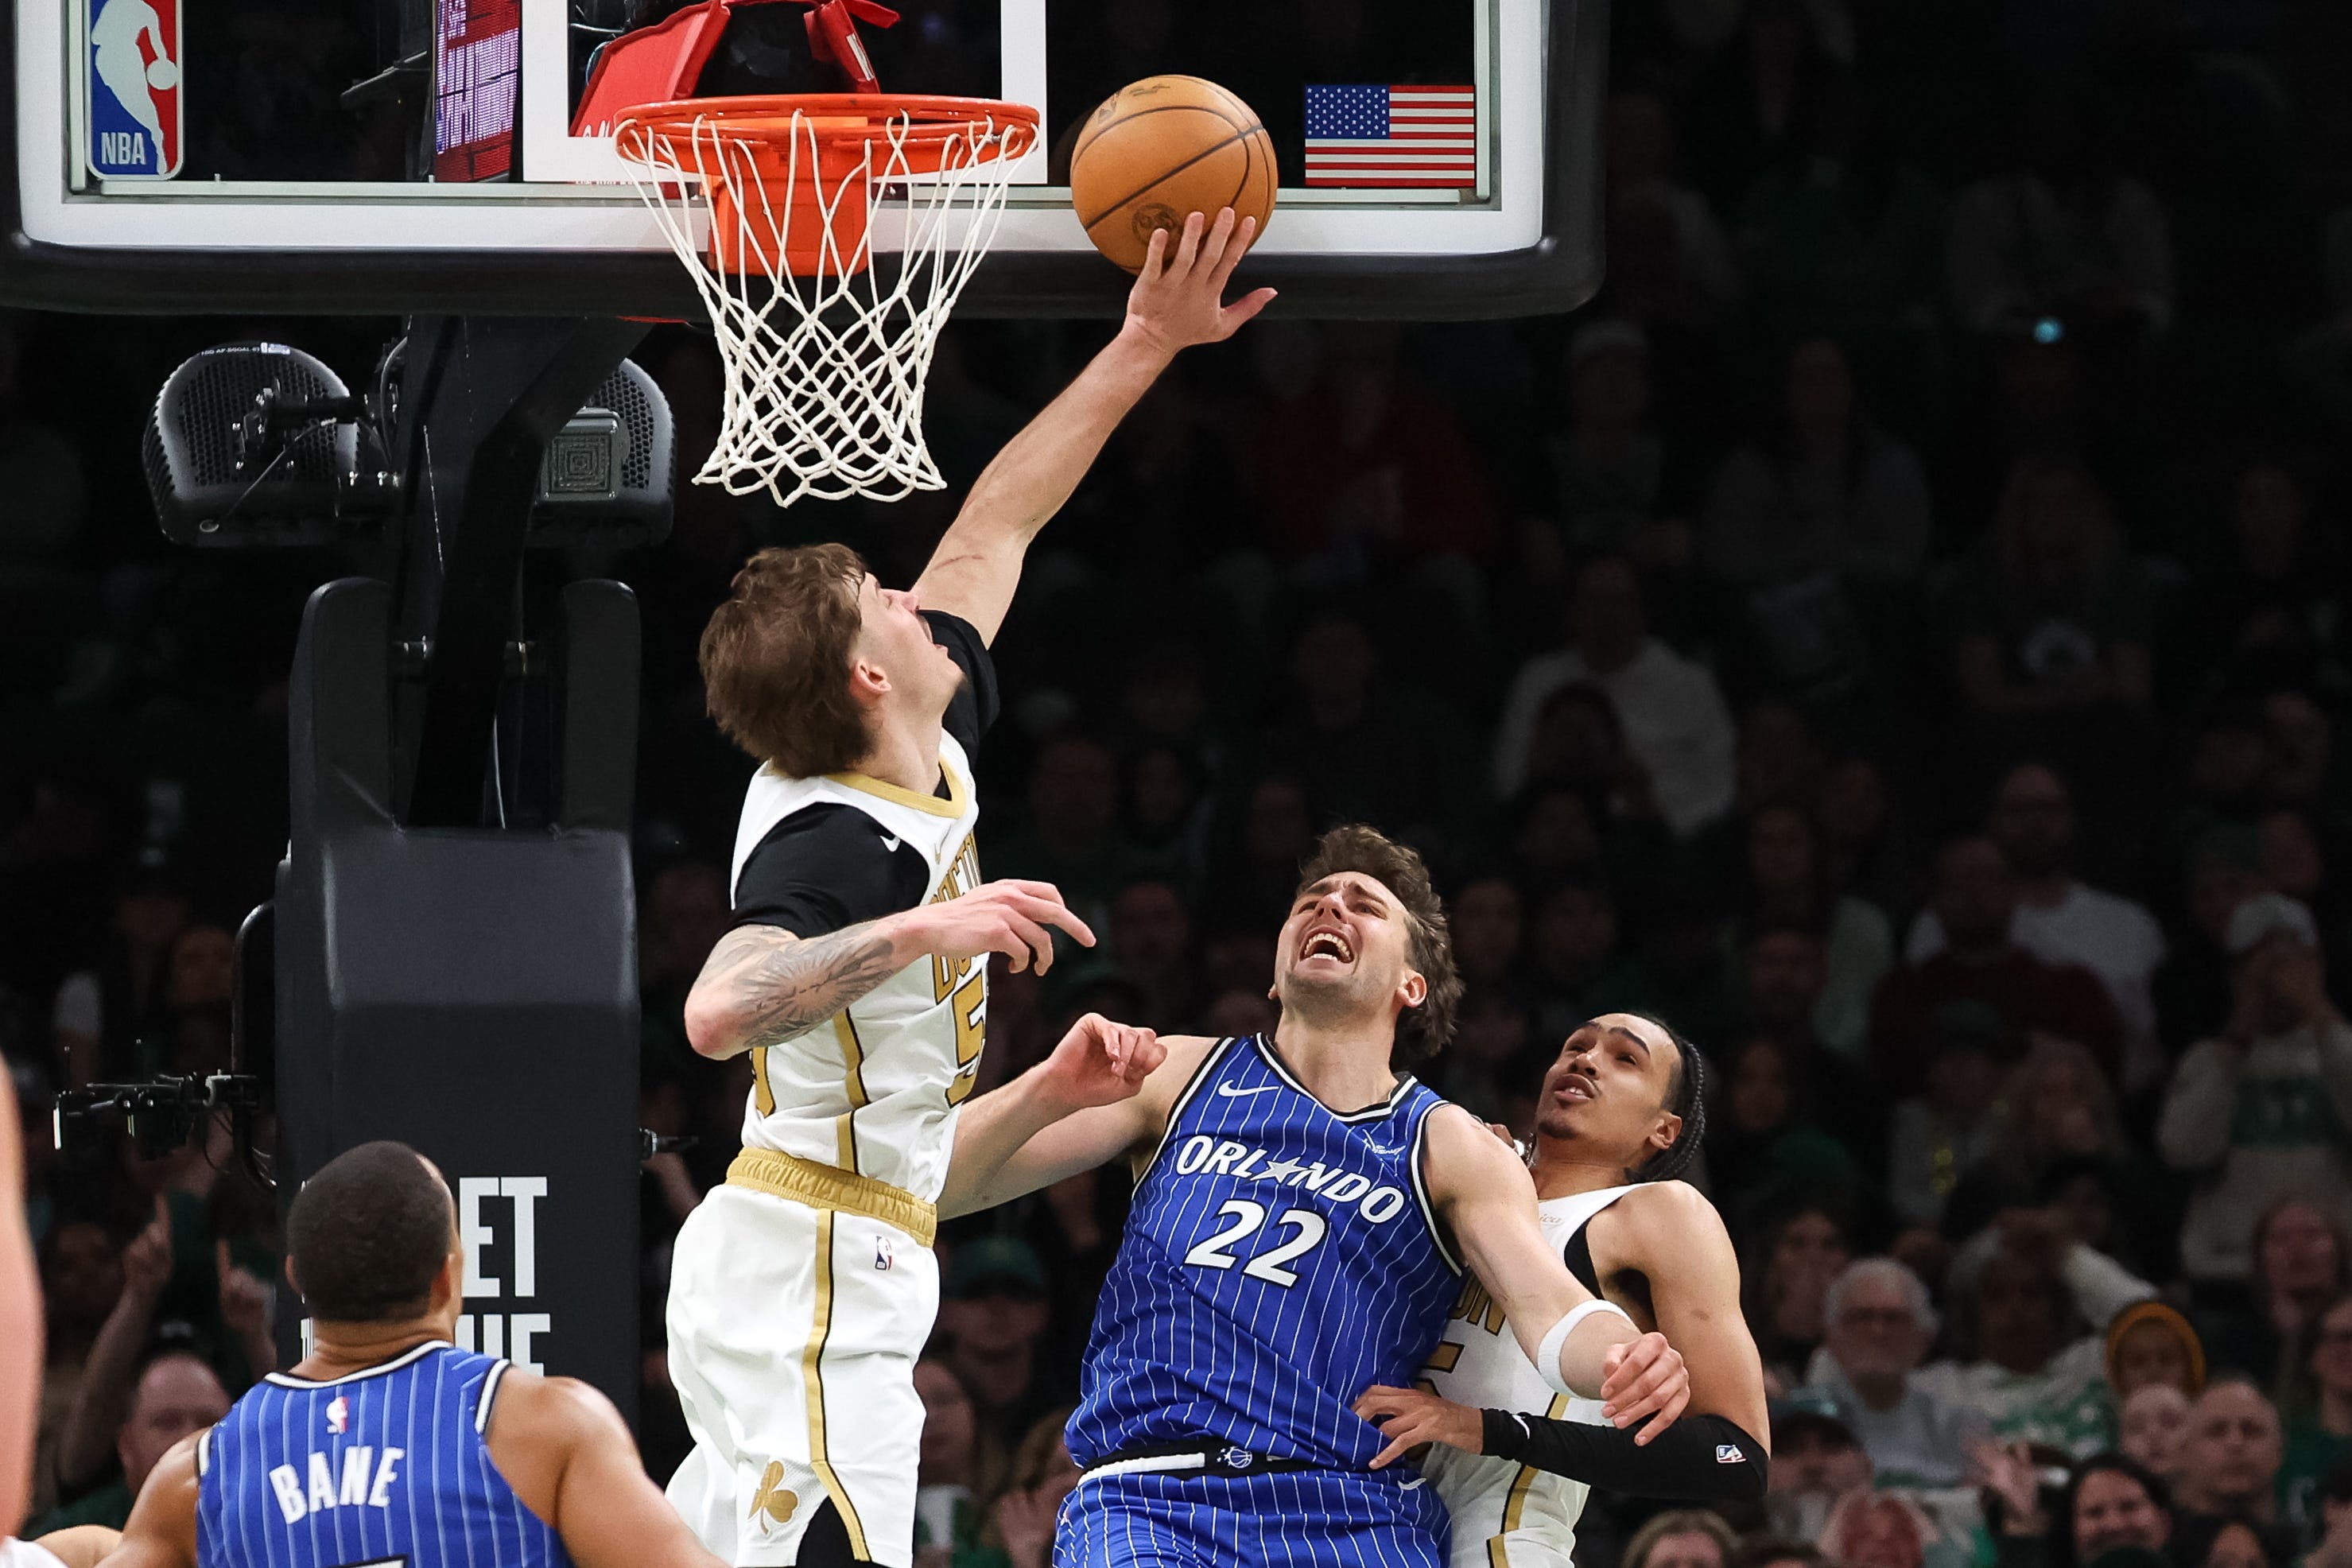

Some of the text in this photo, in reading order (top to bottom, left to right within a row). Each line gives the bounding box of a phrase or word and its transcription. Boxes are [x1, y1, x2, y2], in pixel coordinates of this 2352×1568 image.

[101, 132, 146, 165] NBA
[1183, 1198, 1327, 1288] 22
[268, 1445, 406, 1526] BANE
